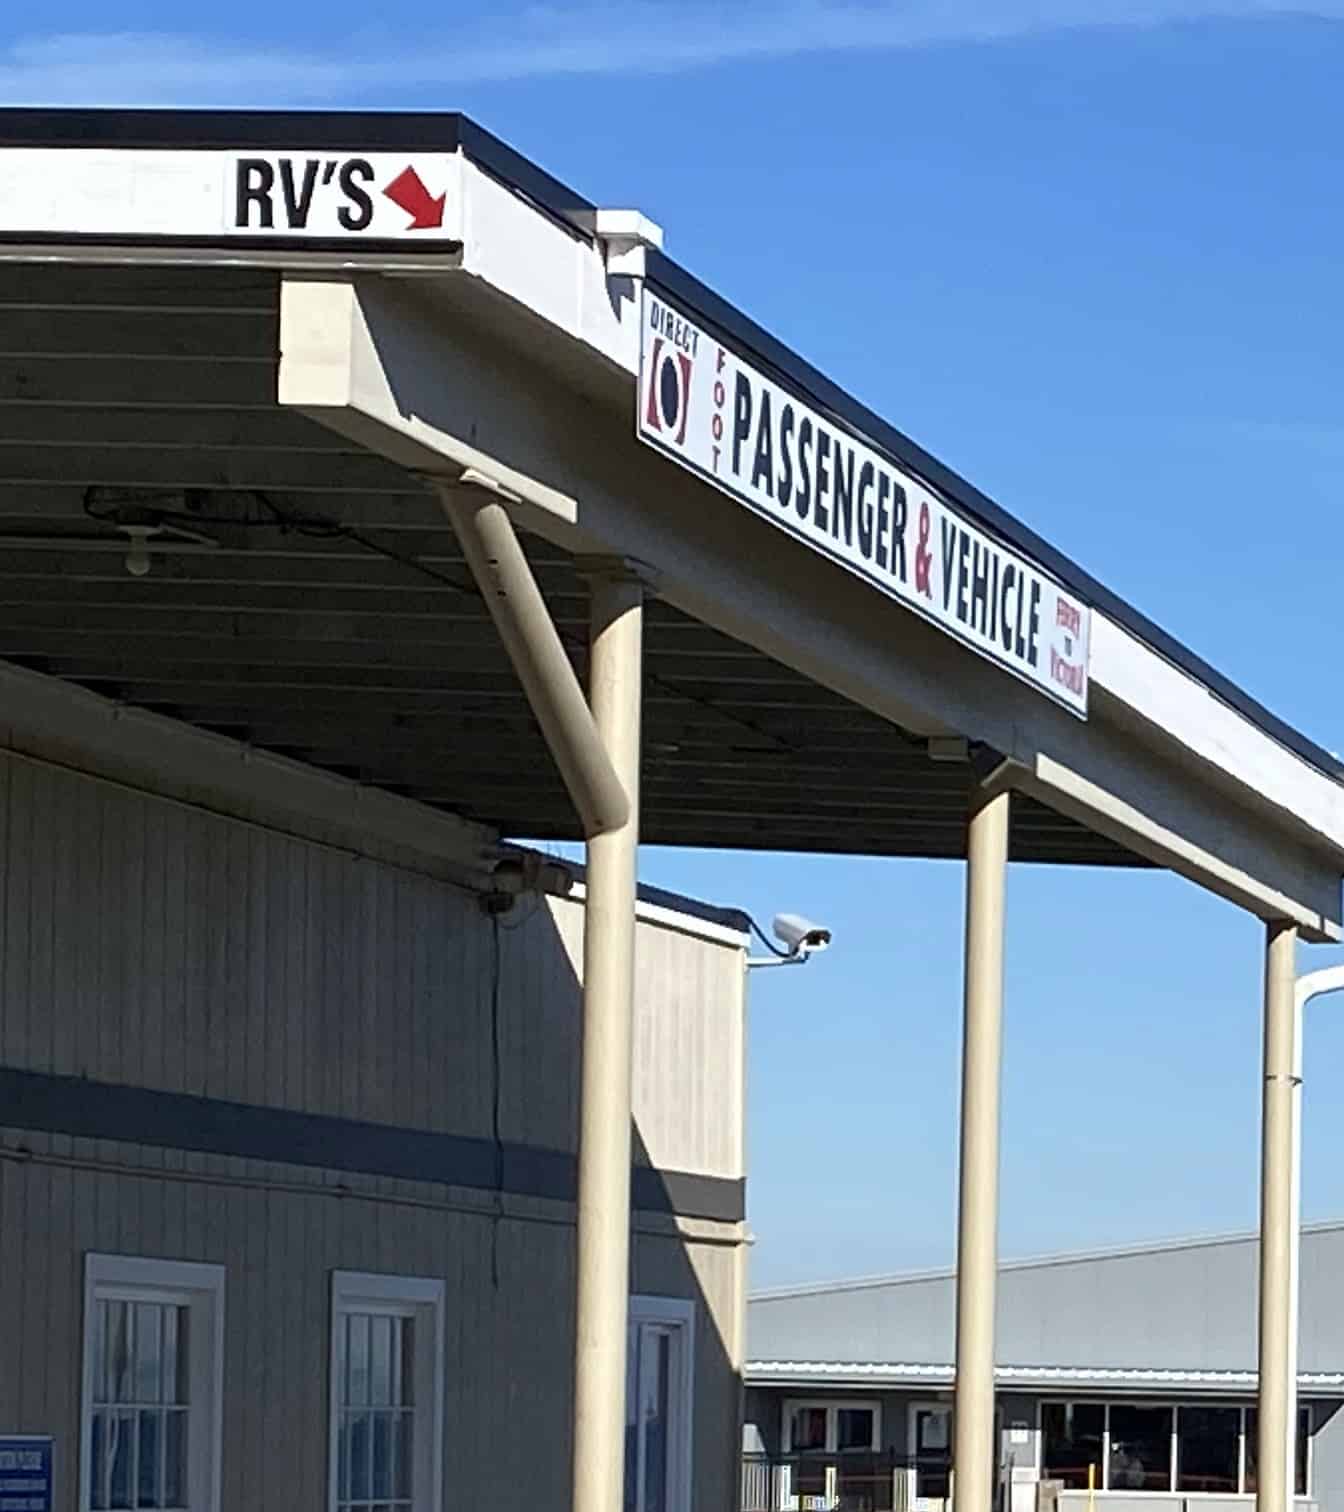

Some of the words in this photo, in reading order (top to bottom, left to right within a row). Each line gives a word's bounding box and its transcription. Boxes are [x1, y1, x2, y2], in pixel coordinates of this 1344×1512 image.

[235, 158, 375, 231] RV'S
[650, 301, 699, 359] DIRECT
[712, 347, 726, 473] FOOT
[732, 370, 908, 584] PASSENGER
[914, 502, 933, 600] &
[940, 515, 1041, 667] VEHICLE
